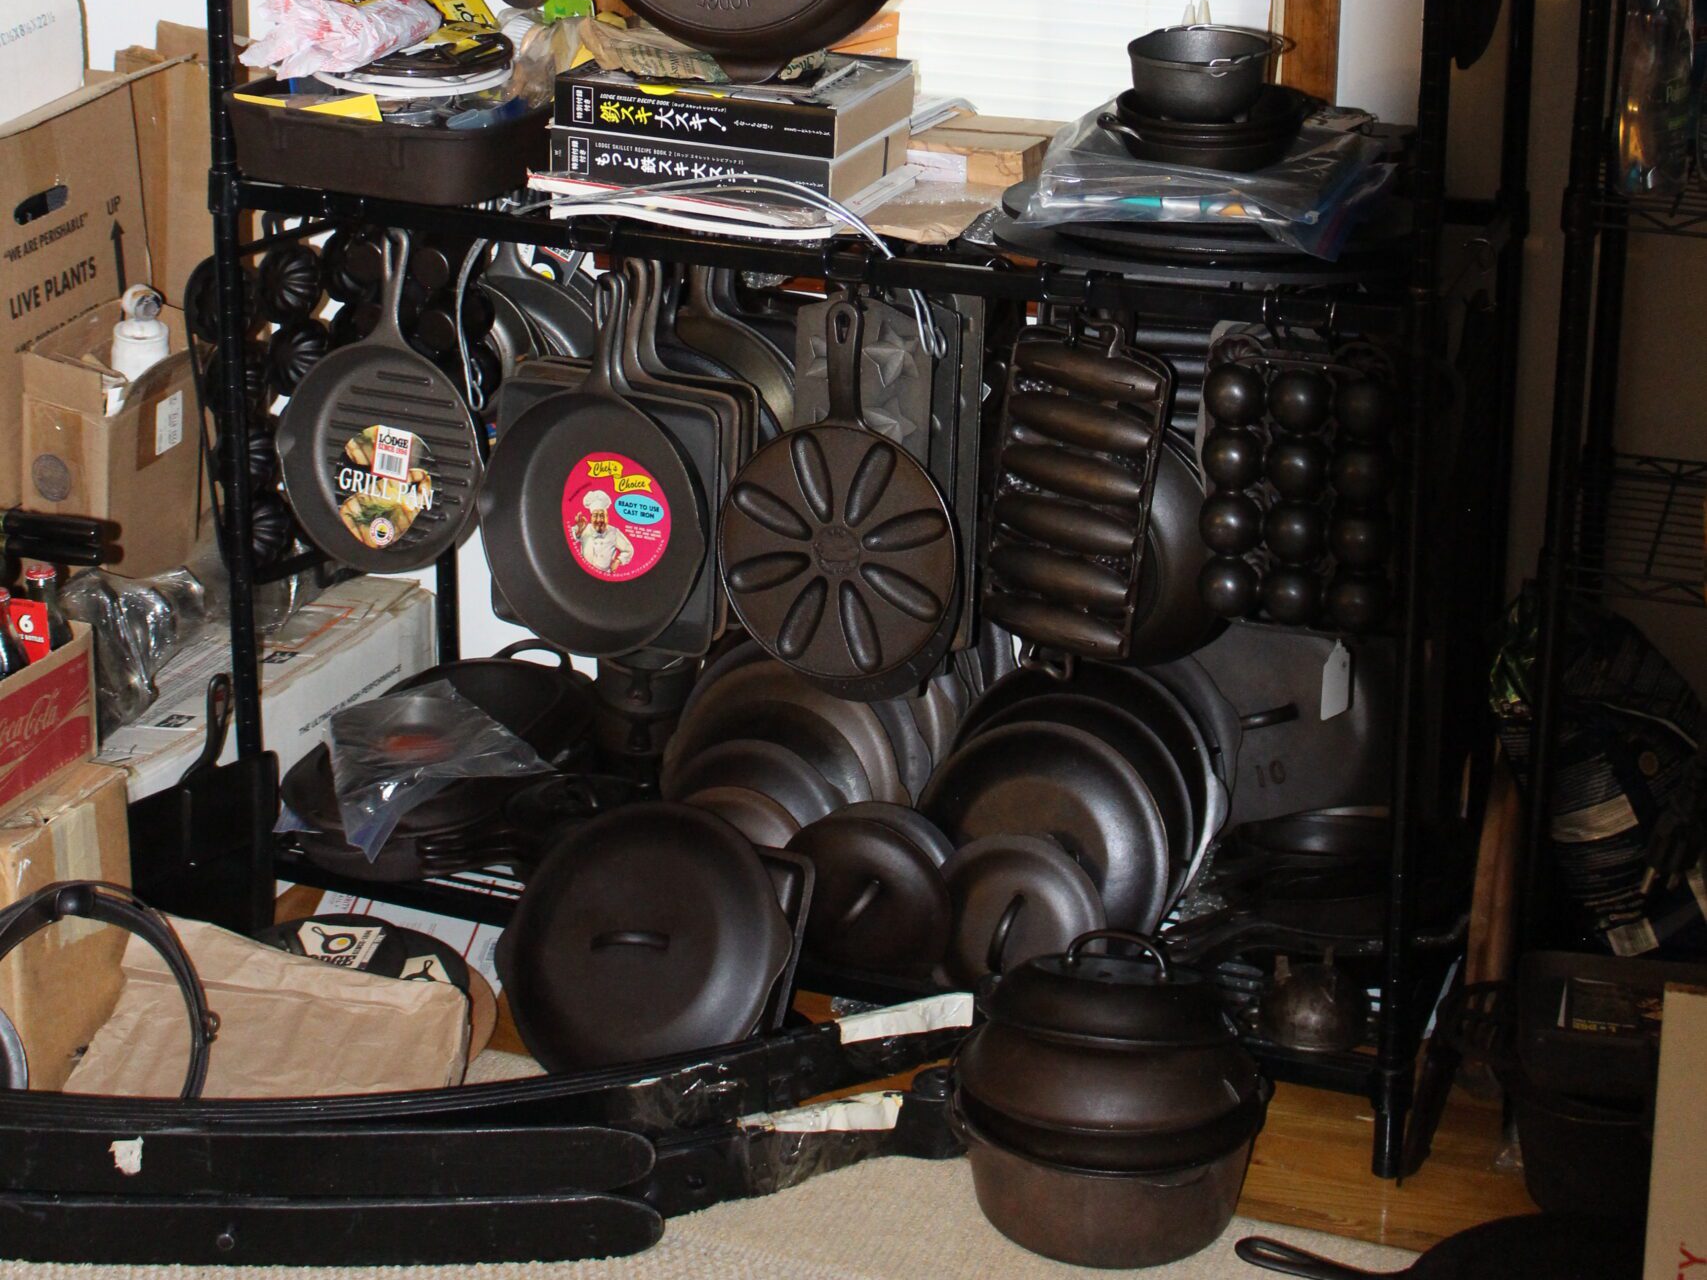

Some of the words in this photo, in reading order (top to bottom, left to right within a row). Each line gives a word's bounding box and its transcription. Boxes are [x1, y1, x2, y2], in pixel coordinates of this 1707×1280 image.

[656, 99, 671, 107] BOOK
[106, 195, 121, 216] UP
[24, 237, 39, 256] ARE
[9, 285, 41, 320] LIVE
[44, 256, 97, 302] PLANTS
[379, 433, 409, 449] LODGE
[593, 462, 618, 476] Chef's
[339, 468, 391, 501] GRILL
[398, 481, 435, 511] PAN
[618, 478, 646, 492] Choice
[618, 500, 638, 509] READY
[640, 511, 655, 519] IRON
[19, 614, 35, 634] 6
